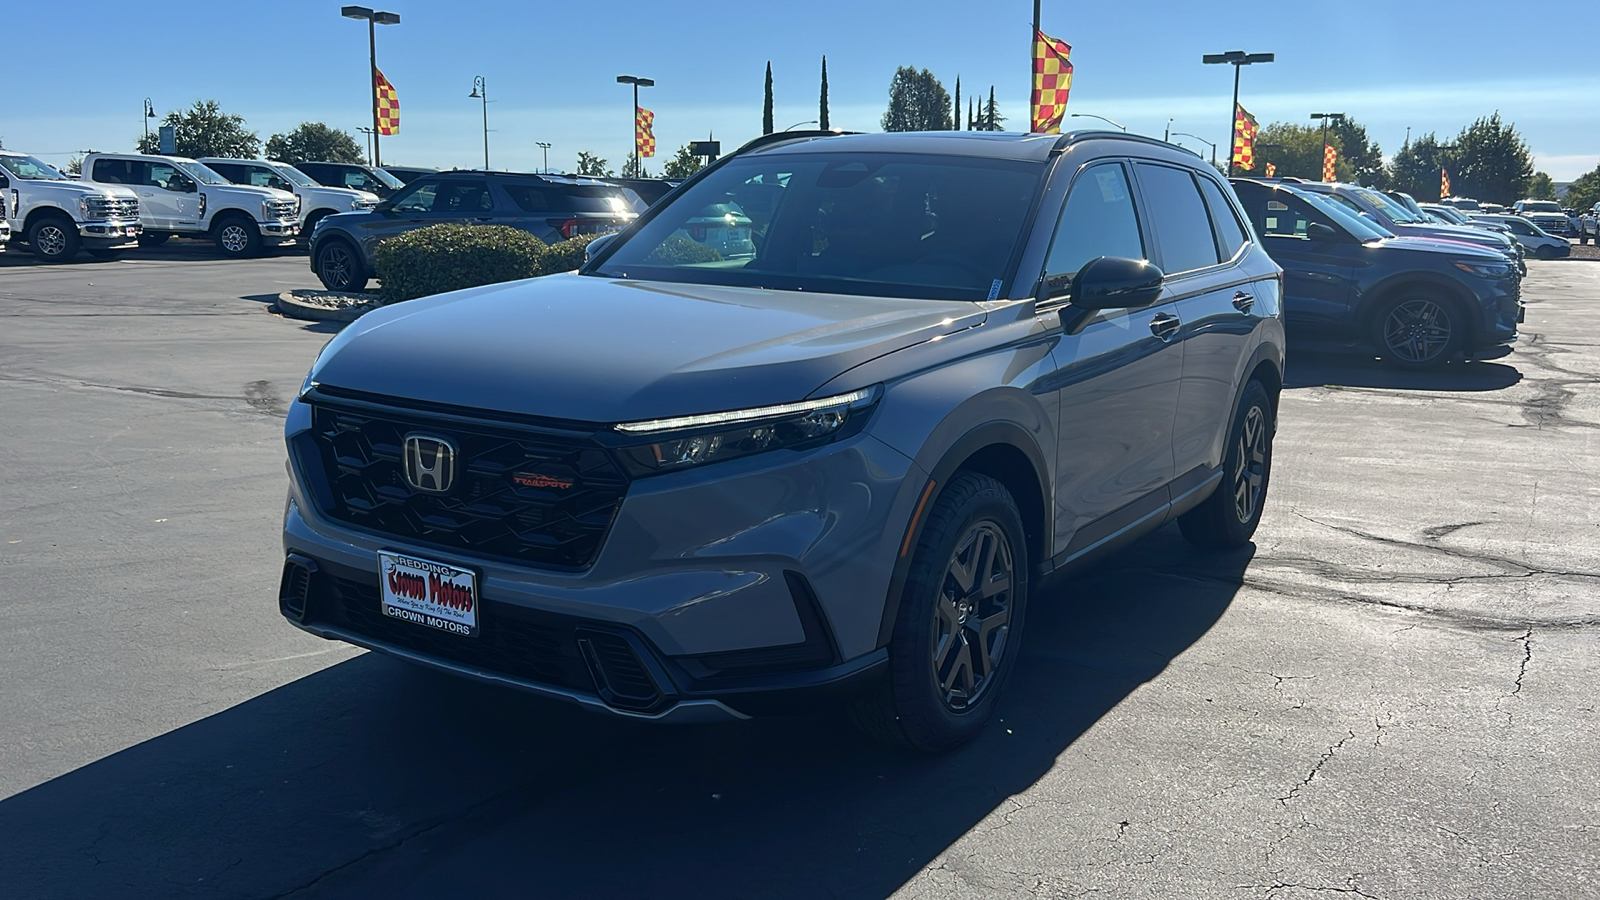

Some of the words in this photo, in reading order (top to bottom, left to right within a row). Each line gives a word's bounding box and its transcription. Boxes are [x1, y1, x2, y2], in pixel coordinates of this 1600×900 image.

[514, 477, 573, 489] TRAILSPORT
[398, 557, 450, 575] REDDING
[388, 566, 426, 601] Crown
[429, 571, 473, 613] Motors
[388, 606, 425, 623] CROWN
[427, 616, 470, 635] MOTORS
